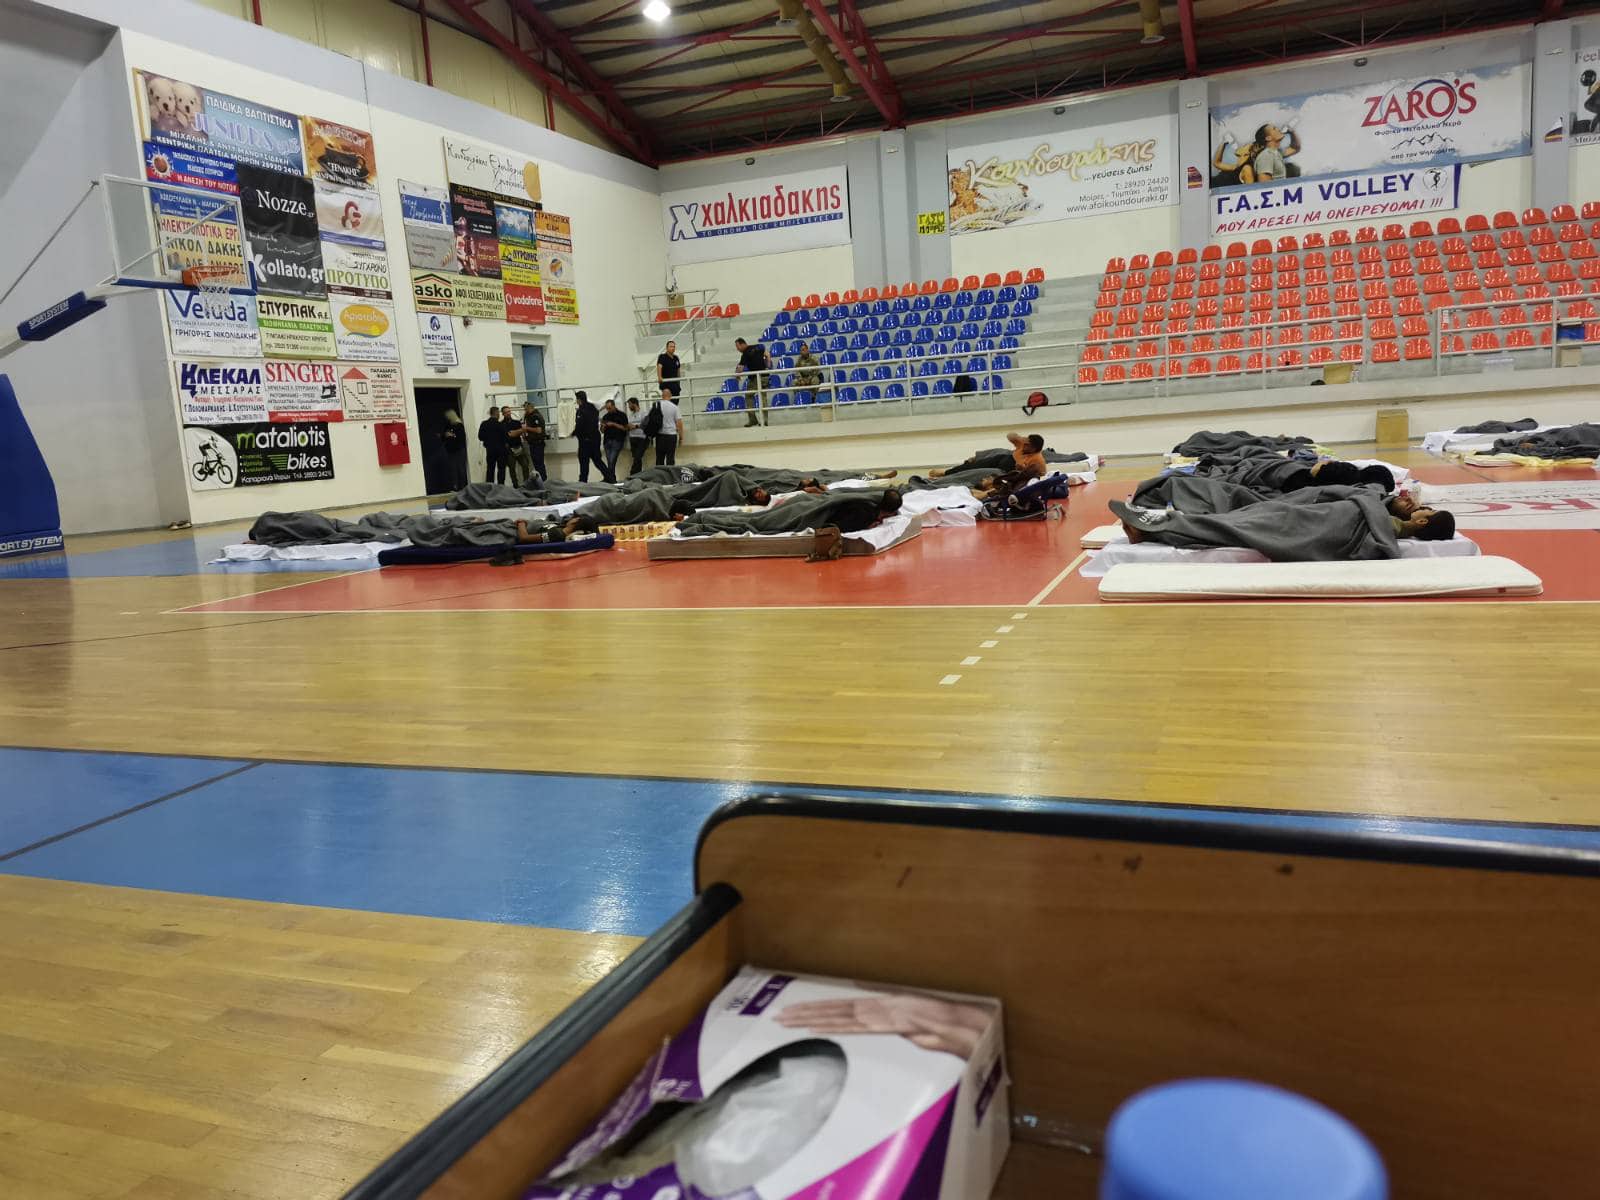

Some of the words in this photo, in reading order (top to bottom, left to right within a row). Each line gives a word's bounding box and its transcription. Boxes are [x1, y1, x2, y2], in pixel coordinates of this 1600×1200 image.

[206, 96, 243, 116] ΠΑΙΔΙΚΑ
[245, 107, 294, 131] ΒΑΠΤΙΣΤΙΚΑ
[1361, 78, 1477, 128] ZARO'S
[1217, 187, 1304, 216] Γ.Α.Σ.Μ
[1319, 173, 1415, 202] VOLLEY
[1216, 219, 1246, 235] ΜΟΥ
[1248, 211, 1299, 231] ΑΡΕΣΕΙ
[1304, 210, 1321, 224] ΝΑ
[1327, 199, 1425, 222] ΟΝΕΙΡΕΥΟΜΑΙ
[717, 227, 748, 236] ΟΝΟΜΑ
[752, 223, 769, 232] ΠΟΥ
[166, 236, 244, 258] ΝΙΚΟΛΔΑΚΗΣ
[326, 269, 389, 290] ΠΡΟΤΥΠΟ
[414, 284, 453, 298] asko
[513, 295, 543, 306] vodafone
[258, 300, 316, 319] ΣΠΥΡΠΑΚ
[175, 329, 211, 338] ΓΡΗΓΟΡΗΣ
[181, 363, 261, 390] ΗΛΕΚΑΛ
[265, 362, 337, 384] SINGER
[200, 386, 261, 395] ΜΕΣΣΑΡΑΣ
[236, 425, 326, 450] mataliotis
[287, 453, 327, 470] bikes
